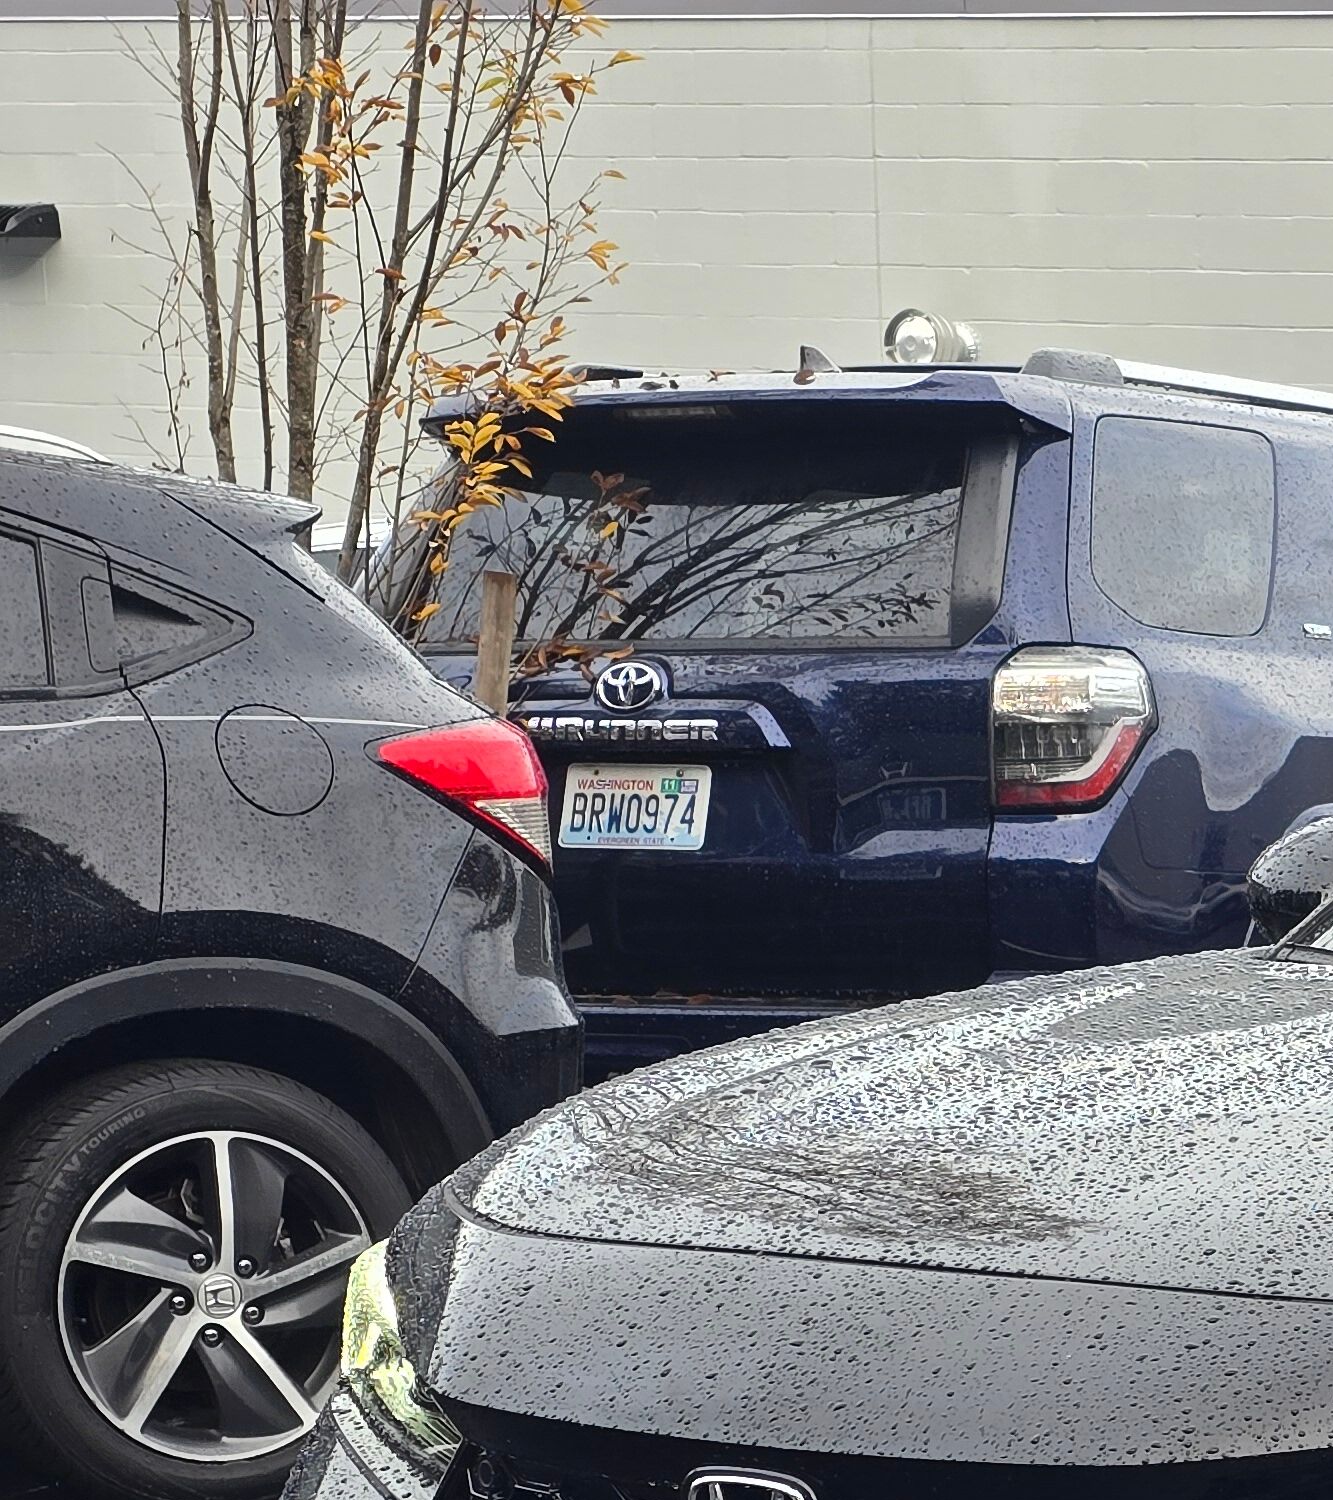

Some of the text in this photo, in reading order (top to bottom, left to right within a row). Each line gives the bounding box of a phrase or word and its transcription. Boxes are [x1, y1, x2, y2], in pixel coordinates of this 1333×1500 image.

[577, 779, 654, 791] WASHINGTON
[663, 780, 678, 791] 11
[569, 792, 696, 834] BRW0974
[84, 1107, 146, 1156] TOURING
